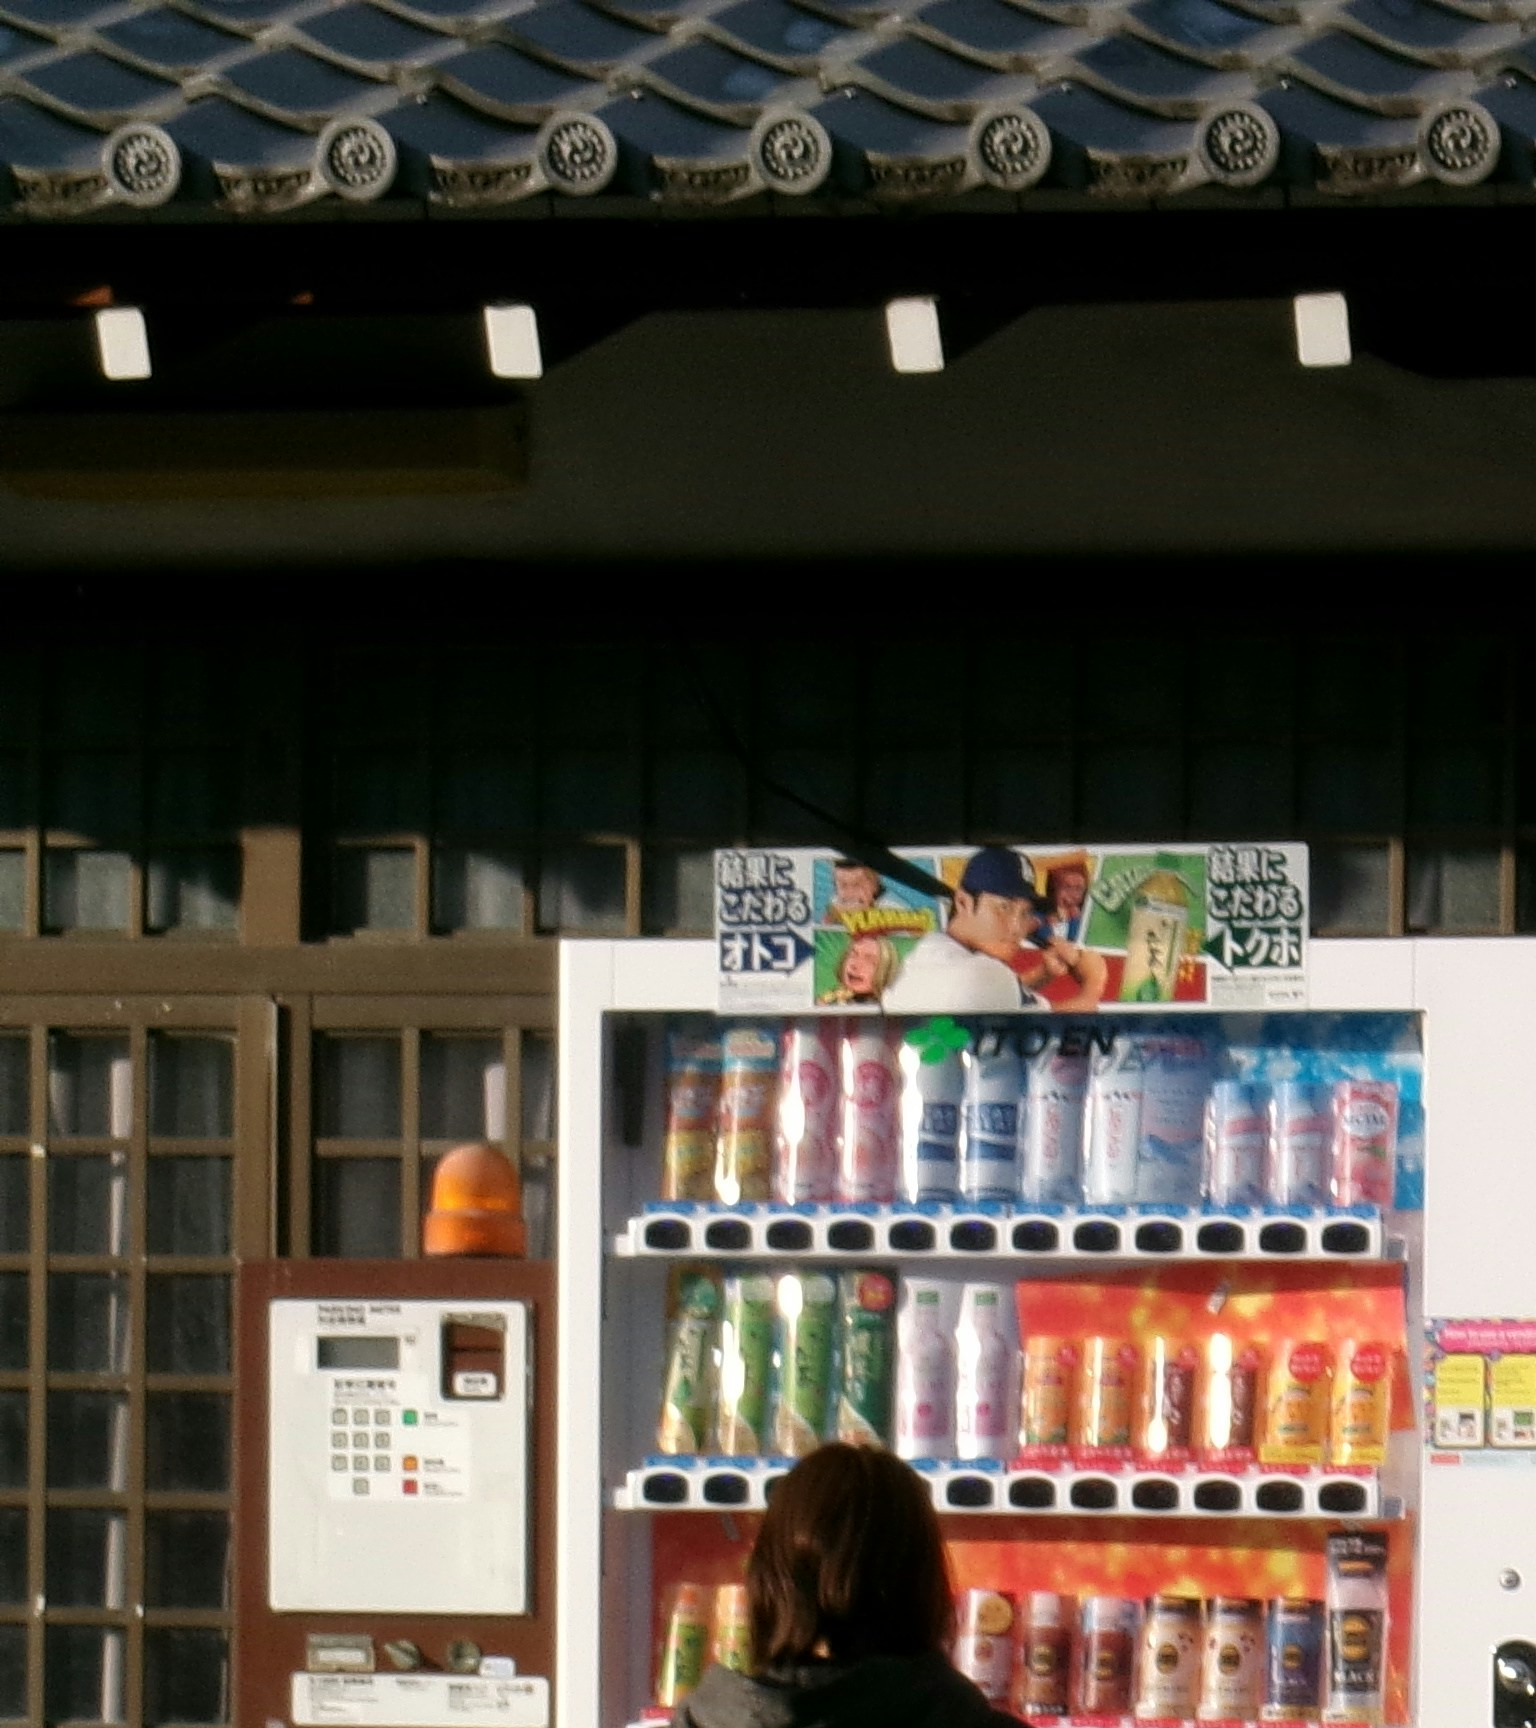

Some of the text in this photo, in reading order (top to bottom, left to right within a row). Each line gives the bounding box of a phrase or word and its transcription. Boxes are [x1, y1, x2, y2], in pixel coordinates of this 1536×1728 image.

[718, 853, 794, 889] 結果に
[1208, 846, 1287, 885] 結果に
[718, 889, 811, 925] こだわる
[1209, 885, 1304, 920] こだわる
[721, 932, 796, 971] オトコ
[1222, 927, 1300, 966] トクホ
[969, 1025, 1121, 1056] ITO EN
